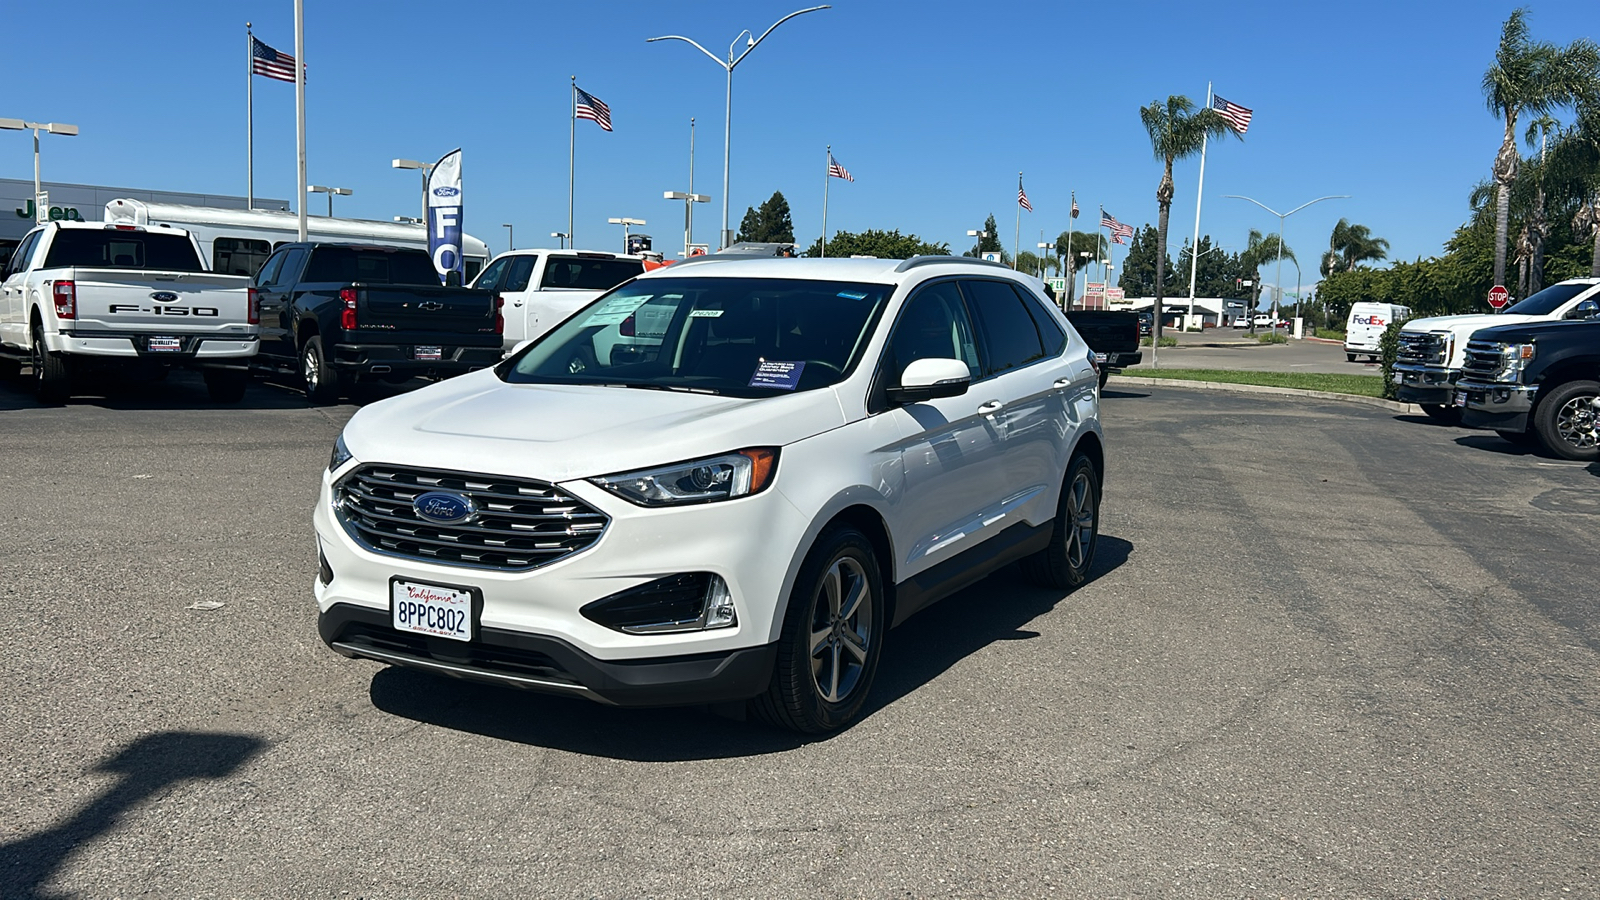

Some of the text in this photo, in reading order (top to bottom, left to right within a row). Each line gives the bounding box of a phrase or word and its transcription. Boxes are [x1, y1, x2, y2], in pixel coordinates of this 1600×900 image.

[436, 187, 457, 196] Ford
[16, 198, 79, 221] Jep
[432, 207, 460, 280] FO
[1489, 292, 1507, 301] STOP
[109, 304, 219, 317] F-150
[1352, 314, 1385, 326] FedEx
[425, 498, 457, 517] Ford
[409, 586, 457, 604] California
[398, 601, 466, 634] 8PPC802
